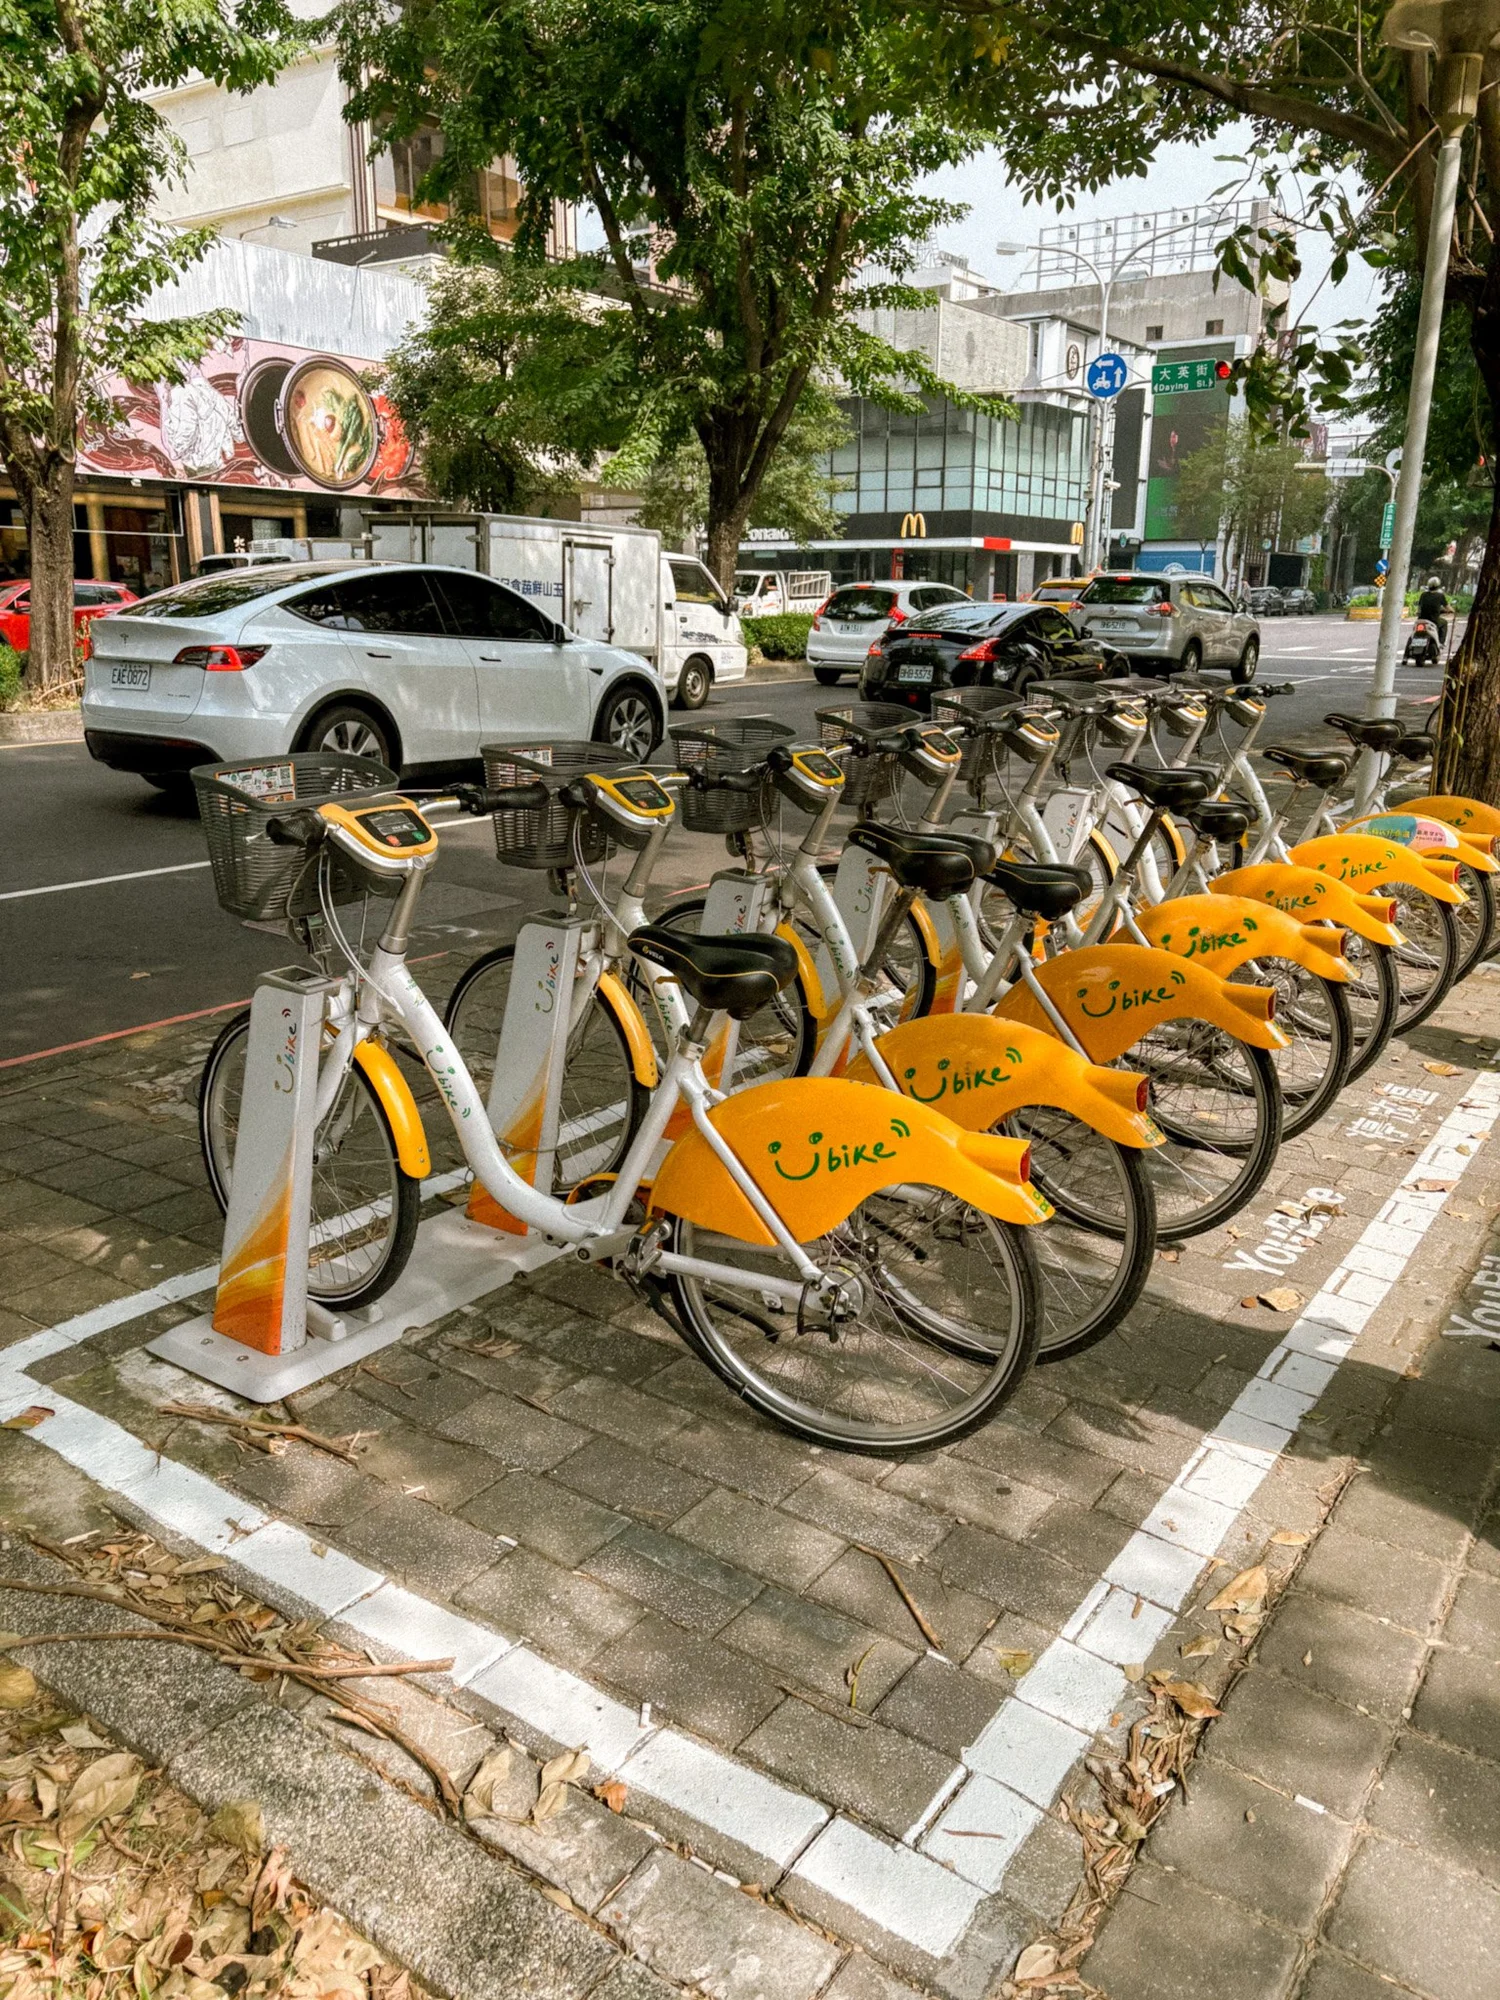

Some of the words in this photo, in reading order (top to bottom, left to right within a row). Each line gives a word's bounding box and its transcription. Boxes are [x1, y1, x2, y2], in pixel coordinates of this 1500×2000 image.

[1159, 364, 1208, 380] 大英街
[1159, 383, 1189, 392] Daying
[112, 668, 148, 686] EAE-0872
